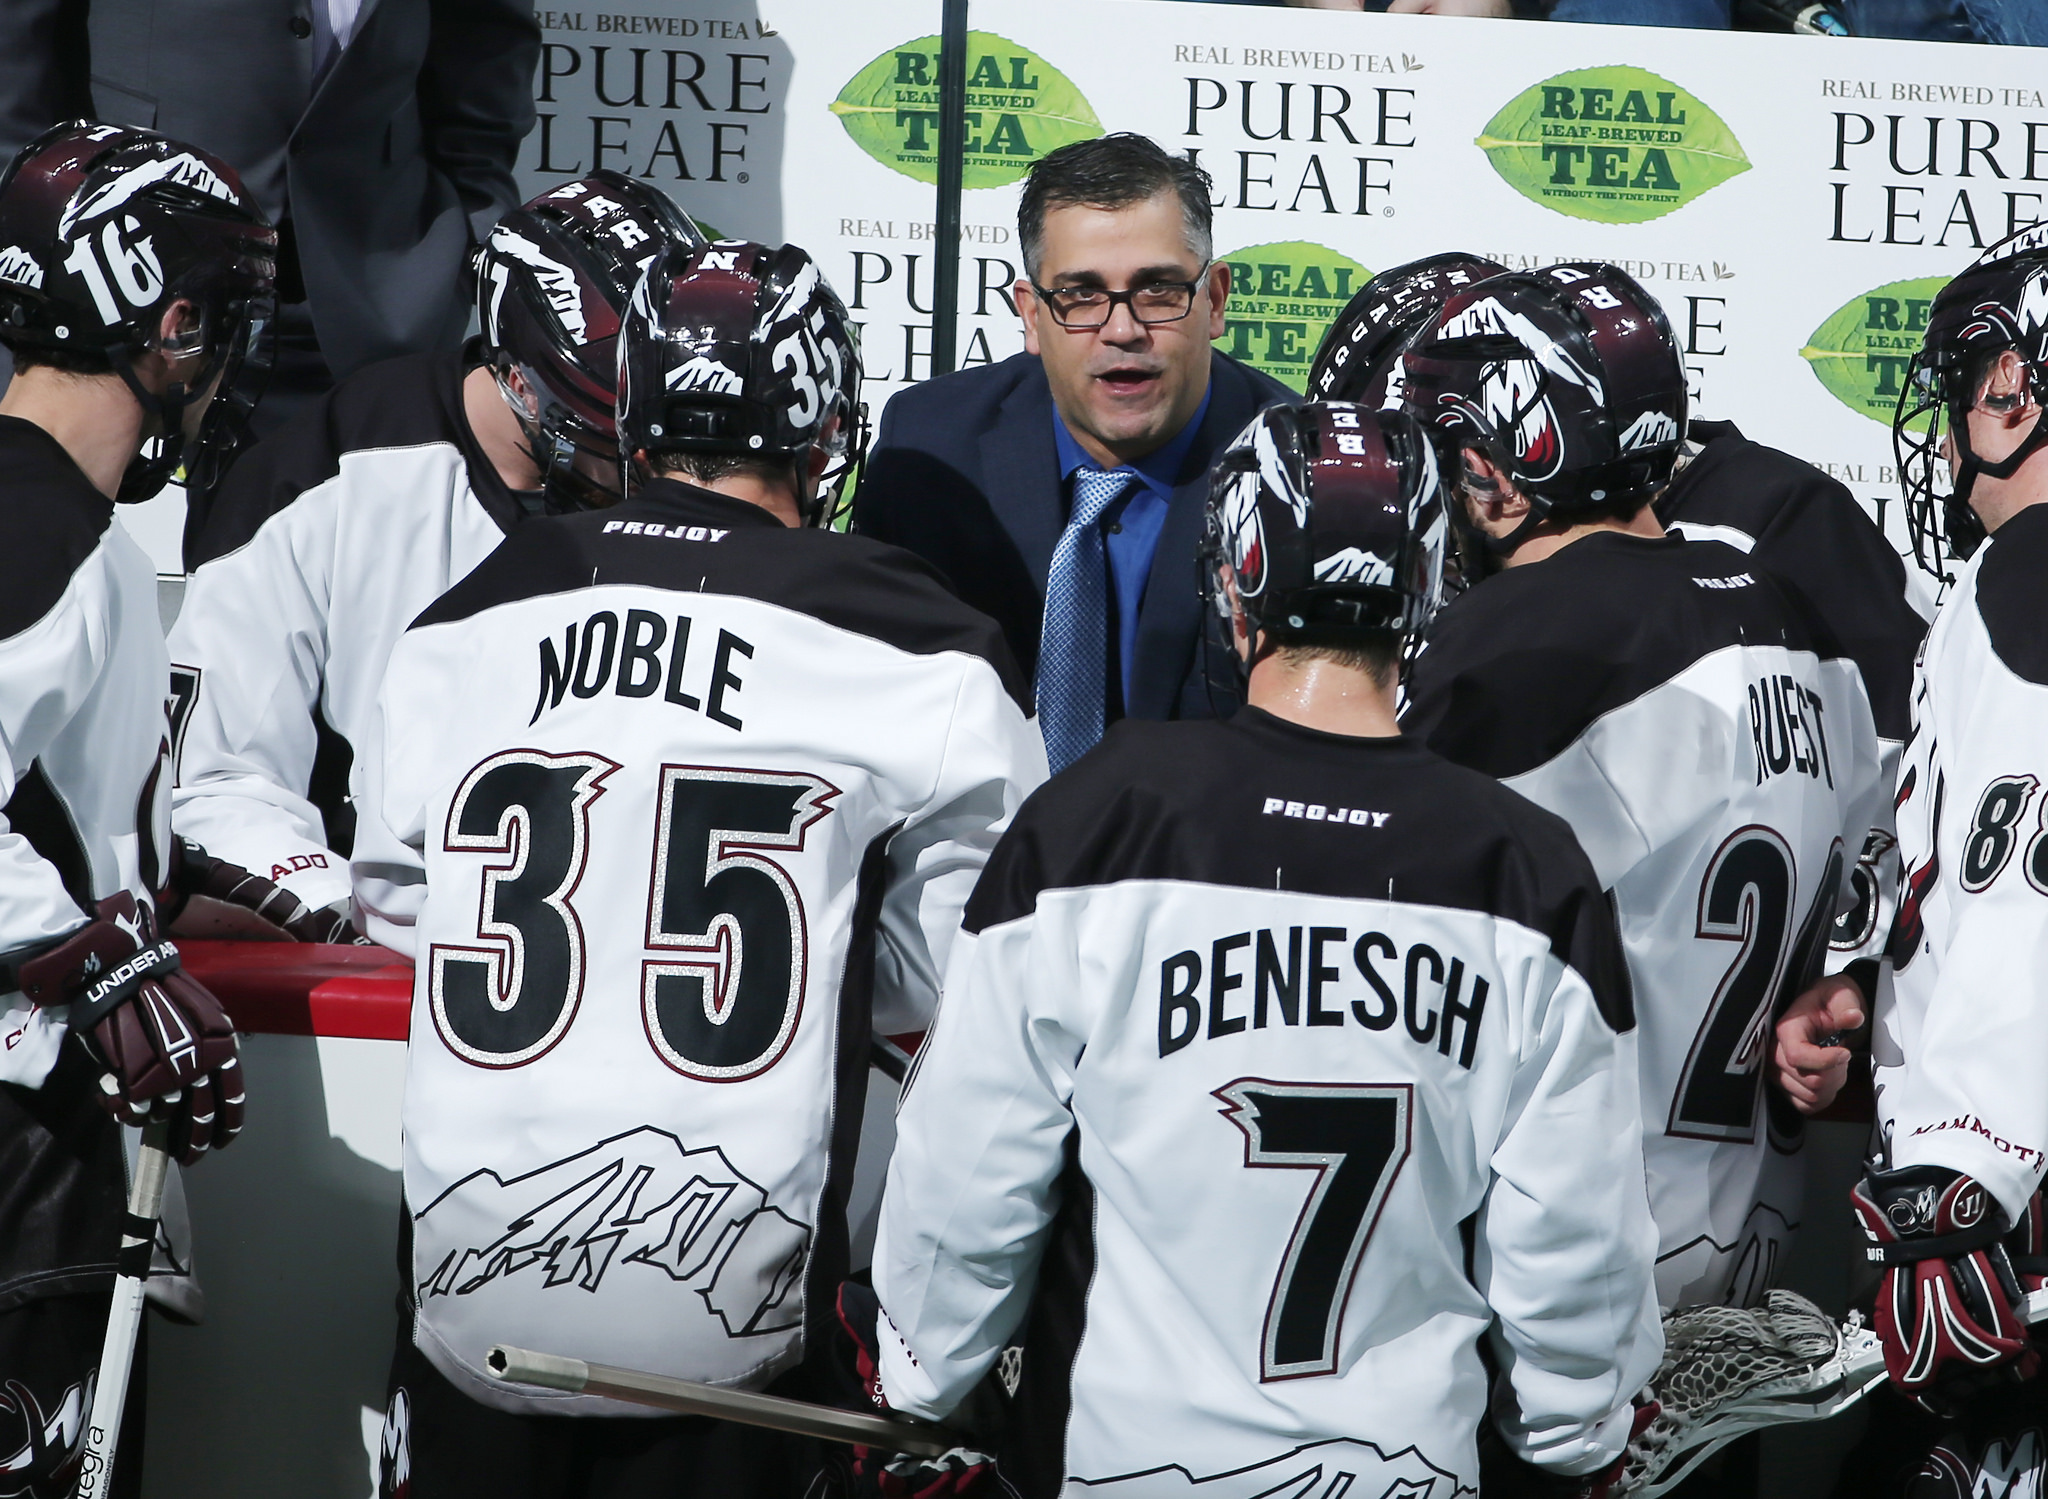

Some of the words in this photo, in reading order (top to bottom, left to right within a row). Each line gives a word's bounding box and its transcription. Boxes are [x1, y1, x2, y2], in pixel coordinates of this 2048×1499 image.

[534, 10, 588, 31] REAL
[596, 14, 699, 37] BREWED
[704, 19, 750, 40] TEA
[535, 43, 771, 114] PURE
[894, 52, 1038, 90] RAL
[1174, 44, 1234, 65] REAL
[1243, 48, 1345, 71] BREWED
[1350, 53, 1397, 74] TEA
[1182, 77, 1416, 148] PURE
[1540, 85, 1686, 125] REAL
[1822, 79, 1881, 100] REAL
[1891, 83, 1993, 105] BREWED
[1999, 88, 2045, 108] TEA
[534, 113, 748, 183] LEAF
[1541, 124, 1682, 143] LEAF-BREWED
[1829, 111, 2048, 182] PURE
[972, 158, 997, 167] FINE
[1541, 144, 1681, 191] TEA
[1542, 188, 1593, 199] WITHOUT
[1595, 191, 1617, 200] THE
[1619, 192, 1644, 201] FINE
[1646, 194, 1679, 203] PRINT
[548, 181, 658, 272] WAR
[839, 218, 899, 239] REAL
[908, 222, 1009, 244] BRWED
[63, 214, 164, 326] 16
[848, 251, 1020, 317] PUR
[1227, 262, 1361, 300] REAL
[1661, 262, 1707, 281] TEA
[1865, 297, 1932, 331] RE
[771, 305, 842, 428] 35
[602, 520, 731, 543] PROJOY
[1692, 572, 1756, 589] PROJOY
[528, 608, 754, 732] NOBLE
[1748, 674, 1834, 791] RUEST
[1262, 797, 1392, 828] PROJOY
[430, 748, 843, 1083] 35
[86, 949, 160, 1003] UNDER
[1158, 925, 1490, 1071] BENESCH
[1664, 823, 1830, 1148] 2
[1210, 1077, 1414, 1384] 7
